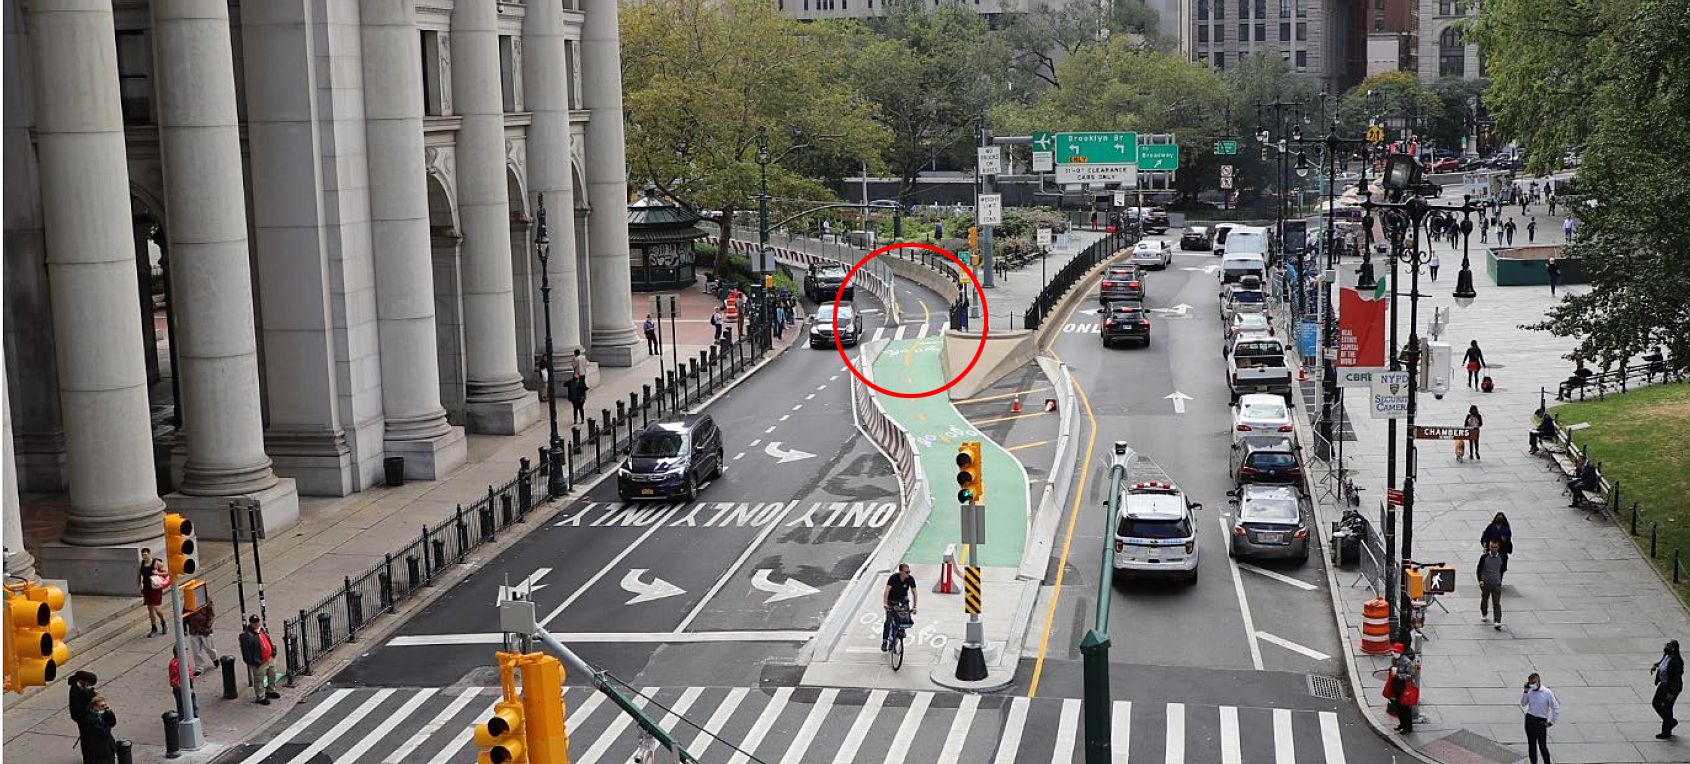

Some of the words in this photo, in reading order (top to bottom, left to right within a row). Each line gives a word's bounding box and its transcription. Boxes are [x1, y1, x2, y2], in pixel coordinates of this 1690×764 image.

[1063, 323, 1101, 333] ONL
[1345, 372, 1372, 381] CBRE
[1381, 374, 1409, 383] NYPD
[1374, 394, 1409, 403] SECURIT
[1423, 428, 1470, 436] CHAMBERS
[553, 502, 672, 527] ONLY
[669, 502, 784, 527] ONLY
[785, 502, 897, 527] ONLY
